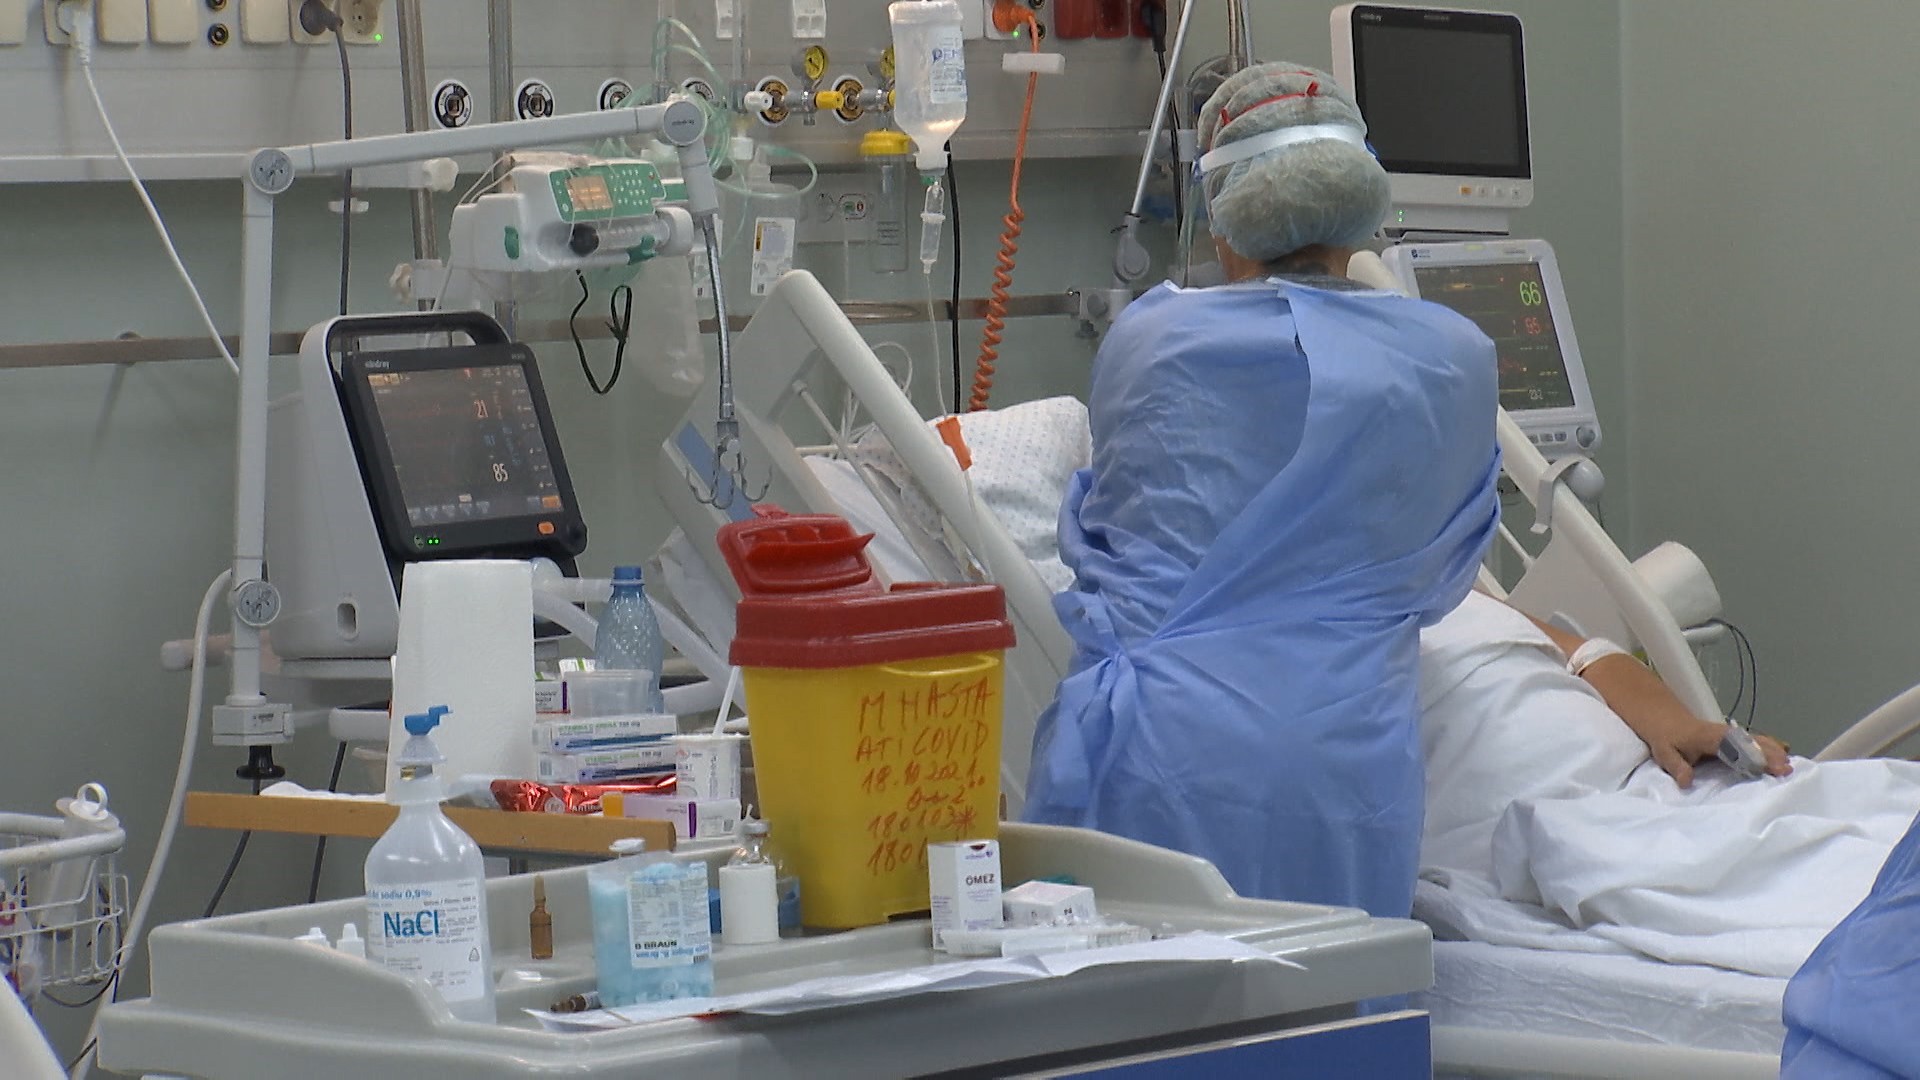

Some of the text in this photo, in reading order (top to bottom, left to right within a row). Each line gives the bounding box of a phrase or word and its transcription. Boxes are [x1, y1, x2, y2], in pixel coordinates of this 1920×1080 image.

[1519, 281, 1542, 306] 66
[473, 399, 489, 419] 21
[492, 463, 509, 482] 85
[965, 873, 995, 886] OMEZ
[383, 909, 440, 938] NaCl
[644, 940, 678, 950] BRAUN
